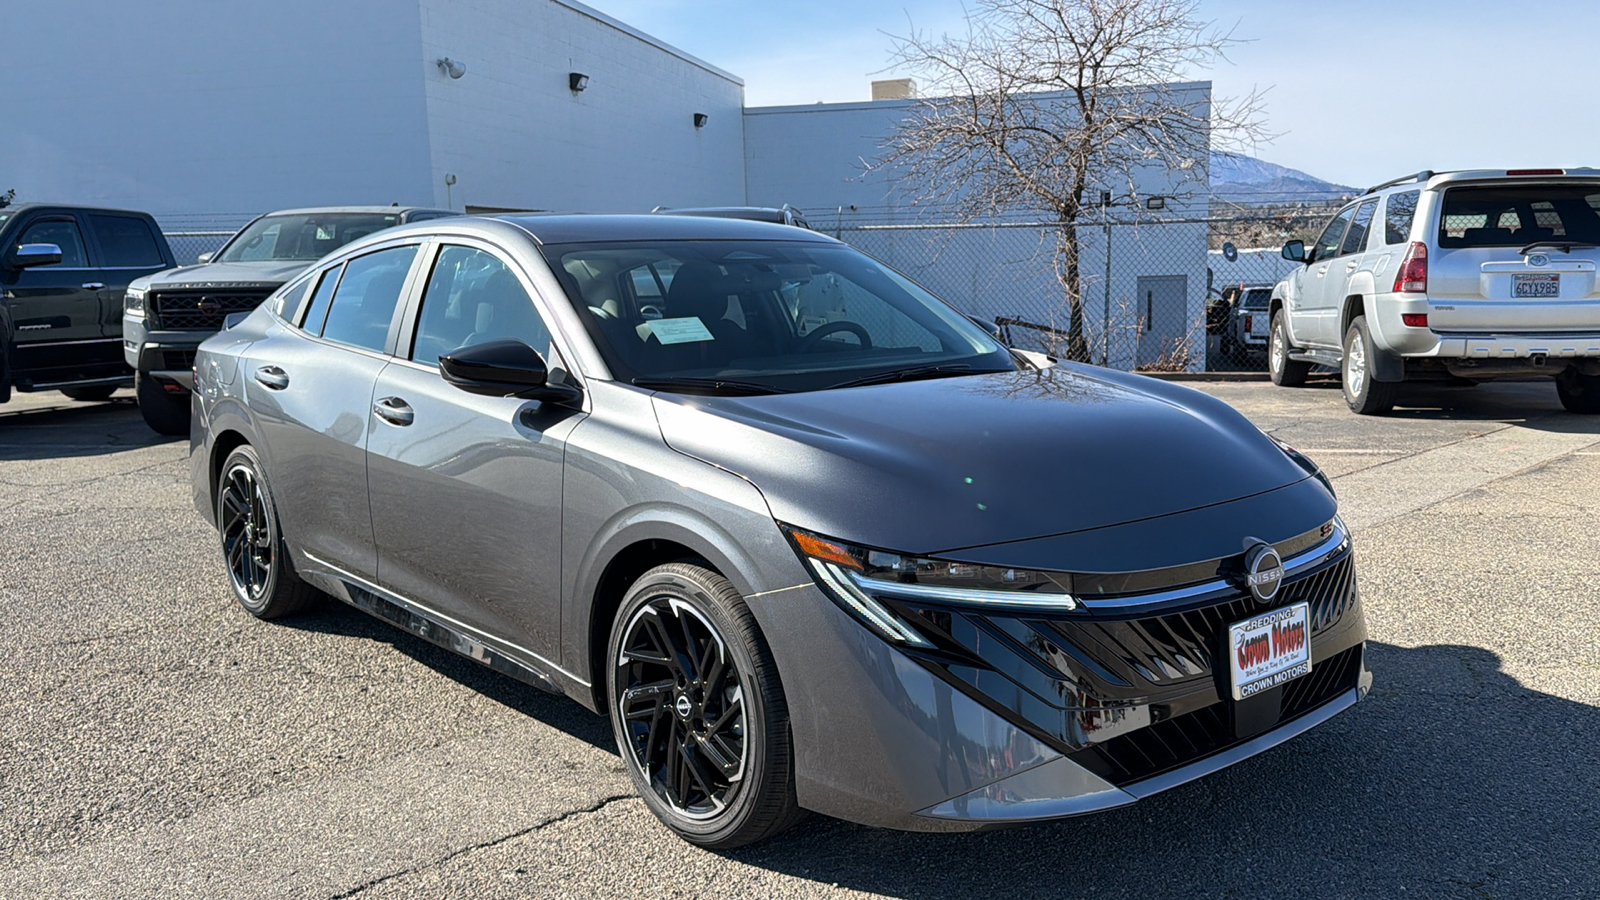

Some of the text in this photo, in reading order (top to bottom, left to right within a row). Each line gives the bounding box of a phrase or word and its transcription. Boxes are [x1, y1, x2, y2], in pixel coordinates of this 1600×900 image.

[1516, 283, 1558, 294] 6CYX985
[1252, 609, 1291, 630] REDDING
[1237, 620, 1305, 670] Crown Motors
[1241, 663, 1308, 696] CROWN MOTORS
